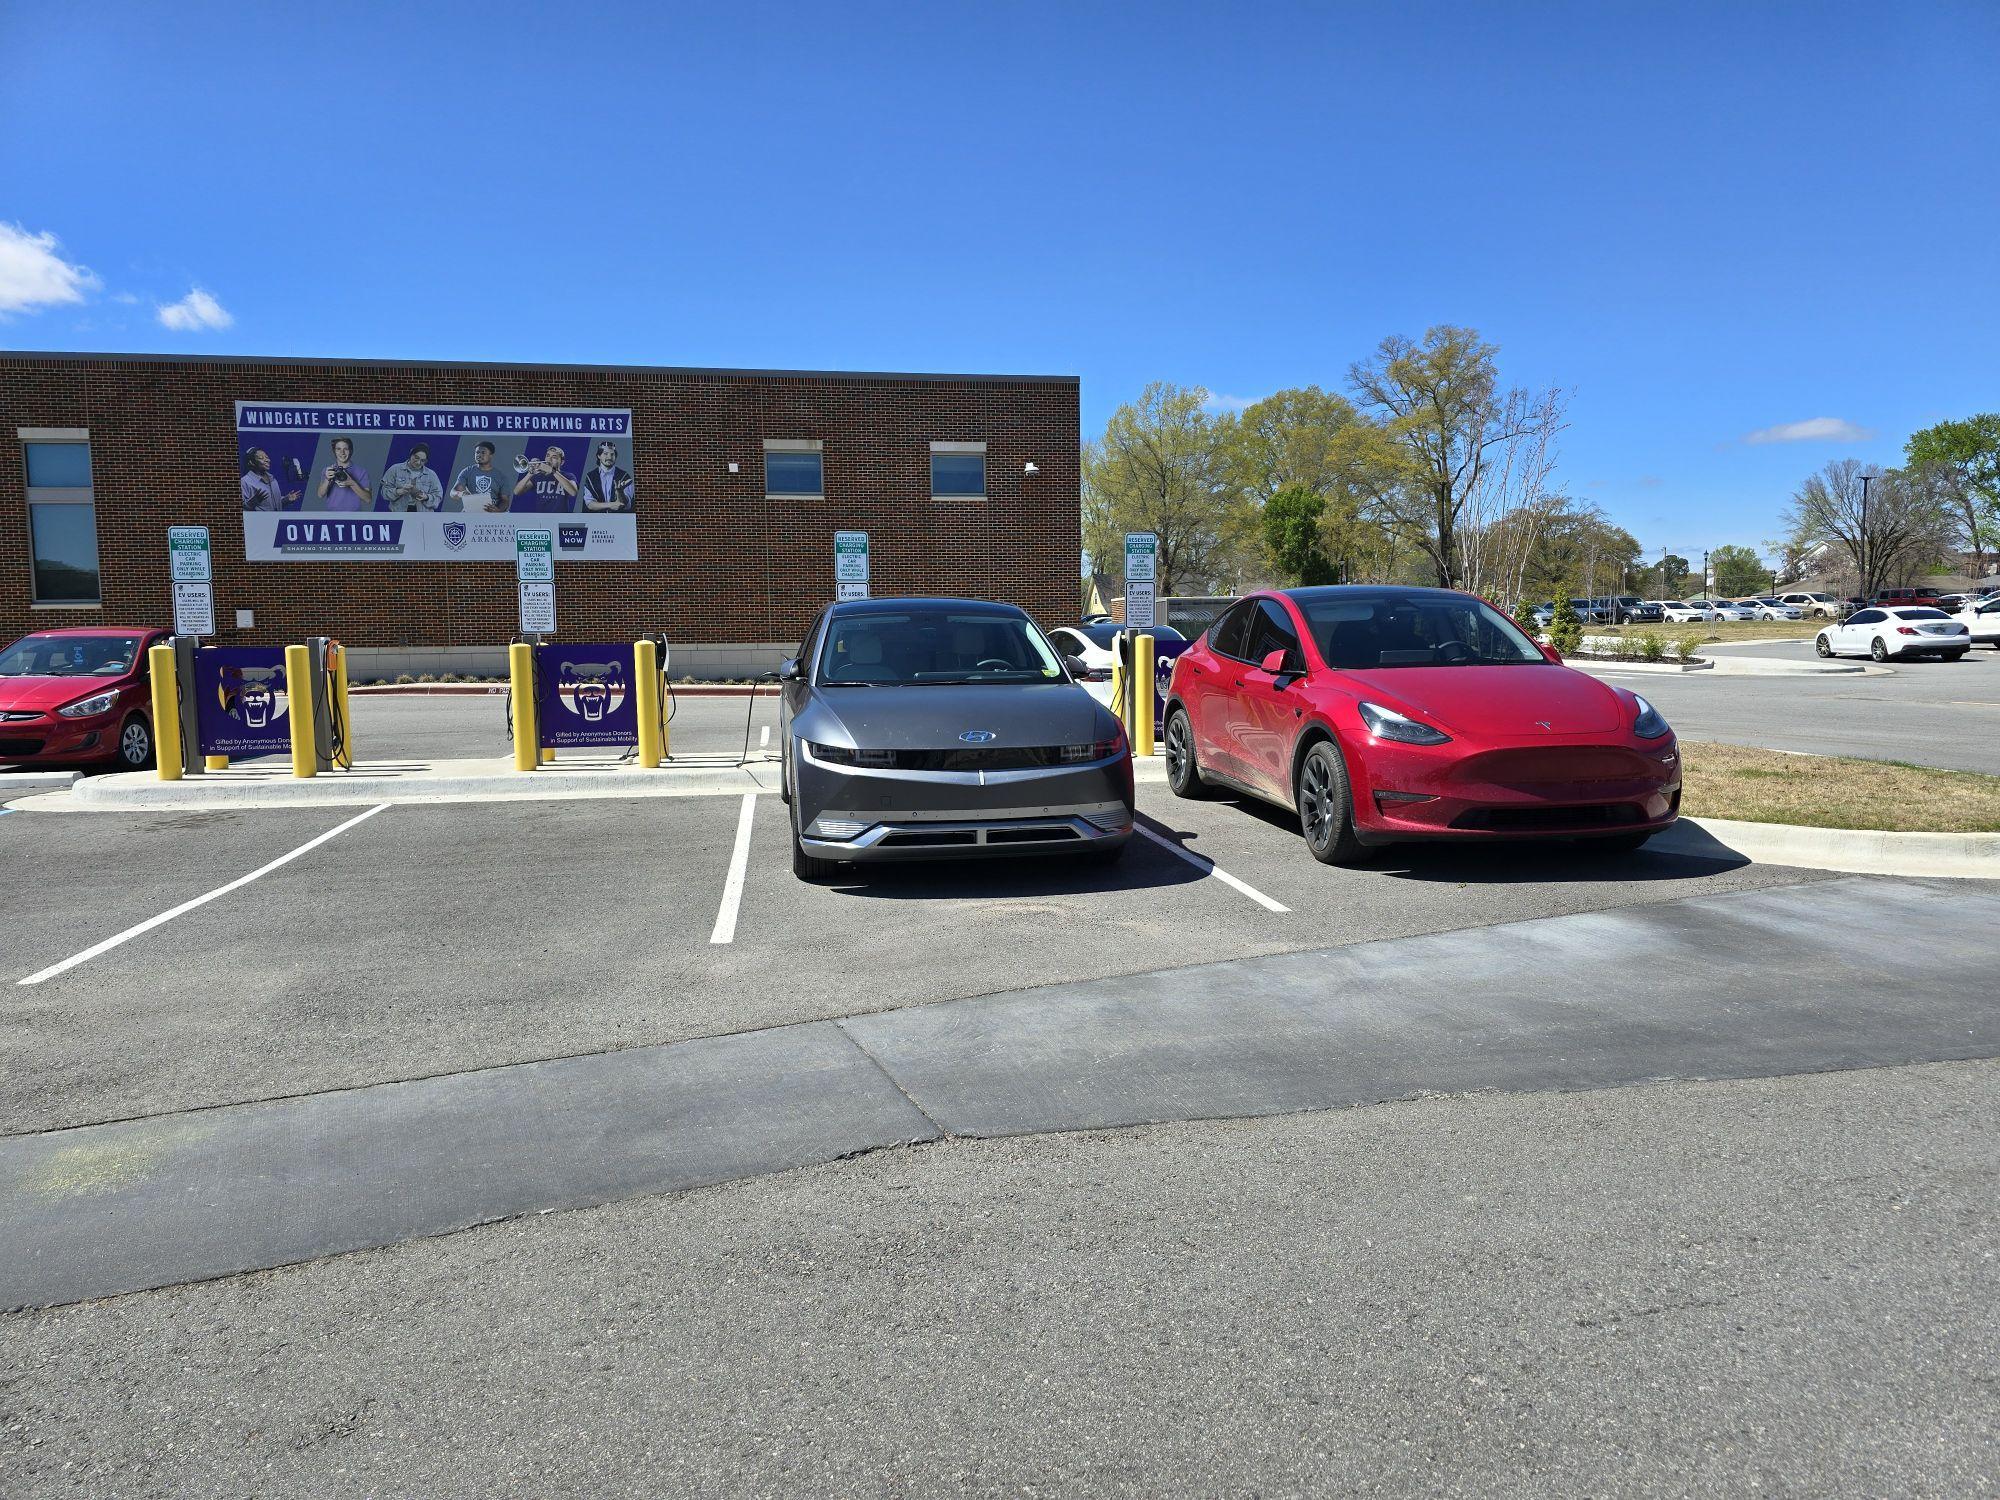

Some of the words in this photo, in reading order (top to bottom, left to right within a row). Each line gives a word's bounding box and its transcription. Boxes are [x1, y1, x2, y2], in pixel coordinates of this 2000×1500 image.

[246, 411, 320, 425] WINDGATE
[328, 412, 381, 426] CENTER
[390, 414, 415, 427] FOR
[424, 414, 454, 428] FINE
[463, 416, 488, 428] AND
[497, 416, 582, 430] PERFORMING
[590, 418, 622, 430] ARTS
[536, 482, 566, 496] UCA
[286, 524, 390, 542] OVATION
